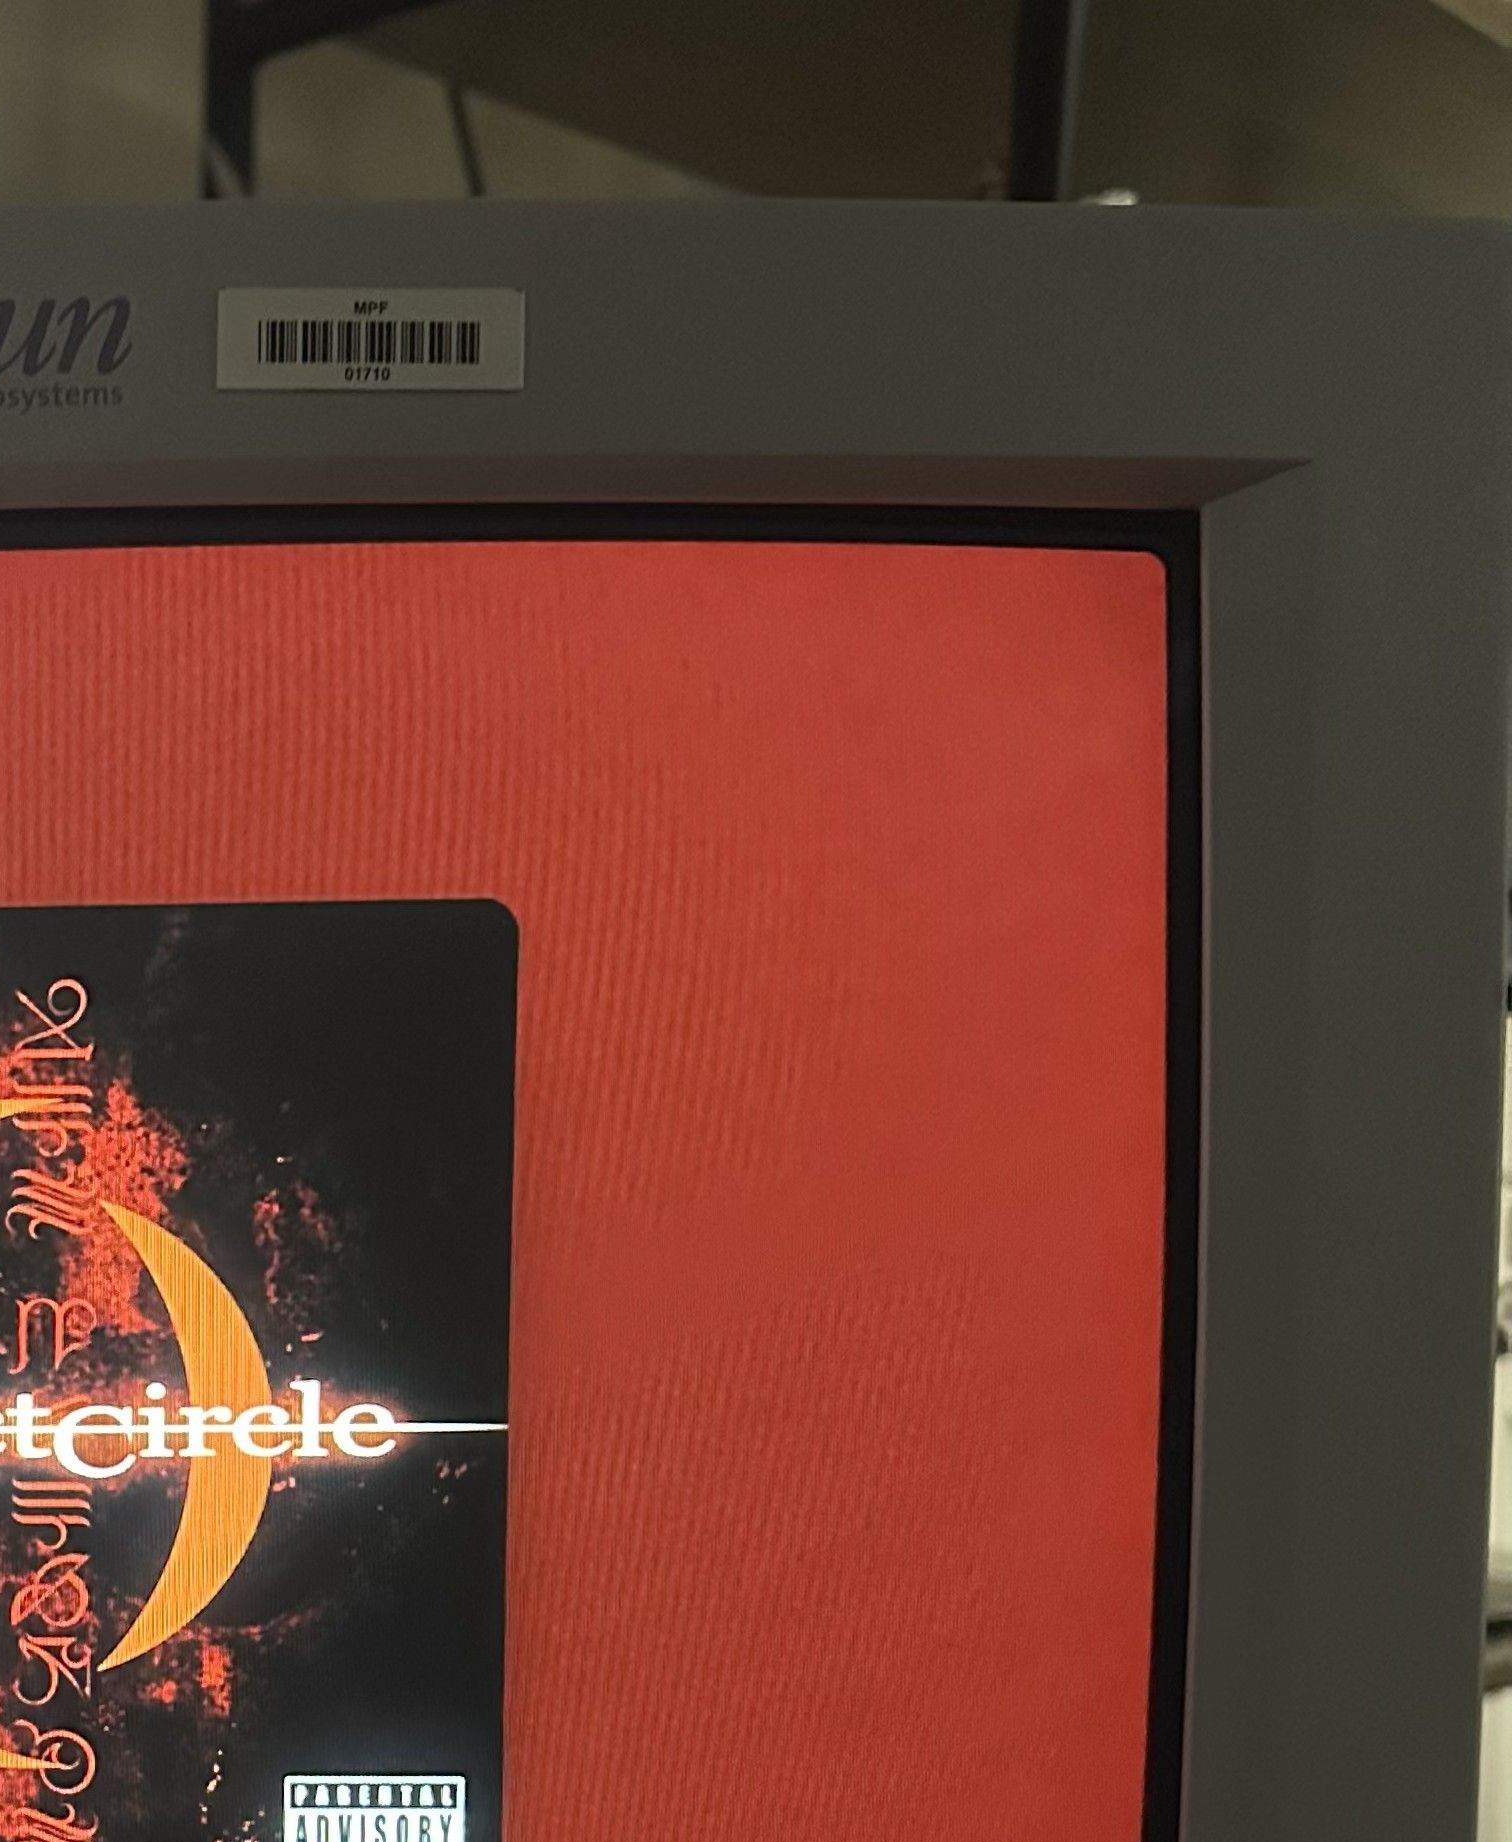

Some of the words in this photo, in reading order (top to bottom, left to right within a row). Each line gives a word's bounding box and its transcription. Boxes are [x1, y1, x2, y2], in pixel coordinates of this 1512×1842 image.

[354, 301, 388, 315] MPF
[345, 367, 390, 381] 01710
[294, 1784, 454, 1807] PARENTAL
